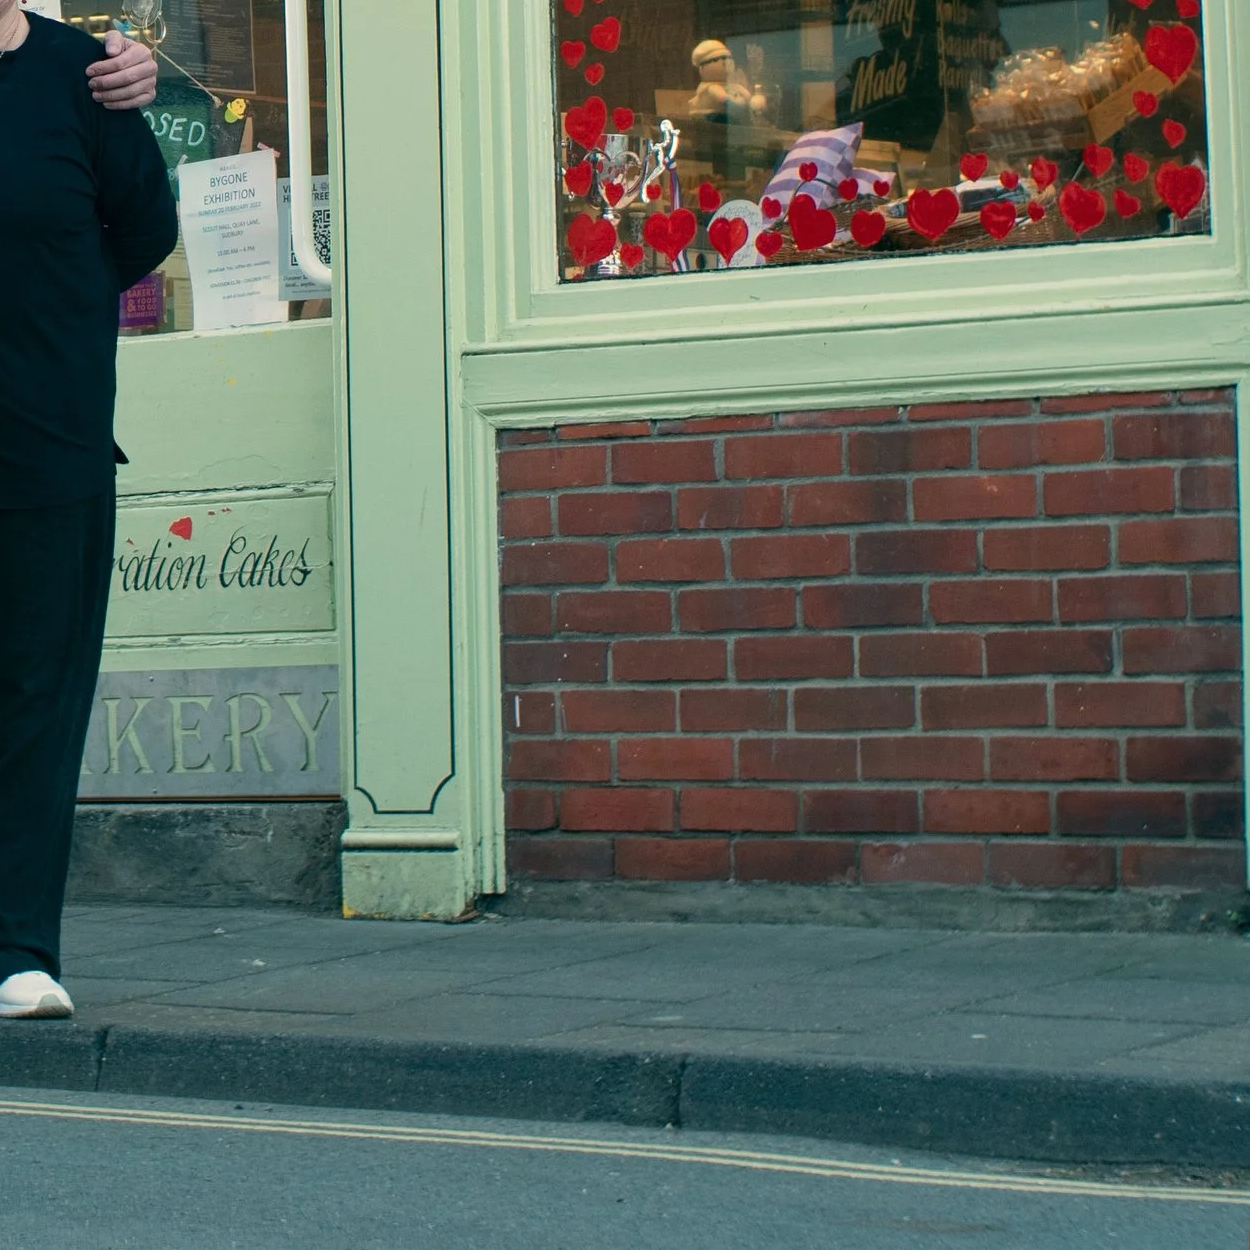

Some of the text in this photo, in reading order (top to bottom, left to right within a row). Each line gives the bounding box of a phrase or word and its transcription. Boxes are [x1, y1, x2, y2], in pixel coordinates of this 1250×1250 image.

[850, 48, 908, 113] Made
[209, 171, 248, 188] BYGONE
[203, 187, 256, 206] EXHIBITION
[225, 204, 249, 212] FEBRUARY
[126, 287, 157, 298] BAKERY
[218, 525, 314, 588] Cakes
[101, 691, 339, 775] KERY
